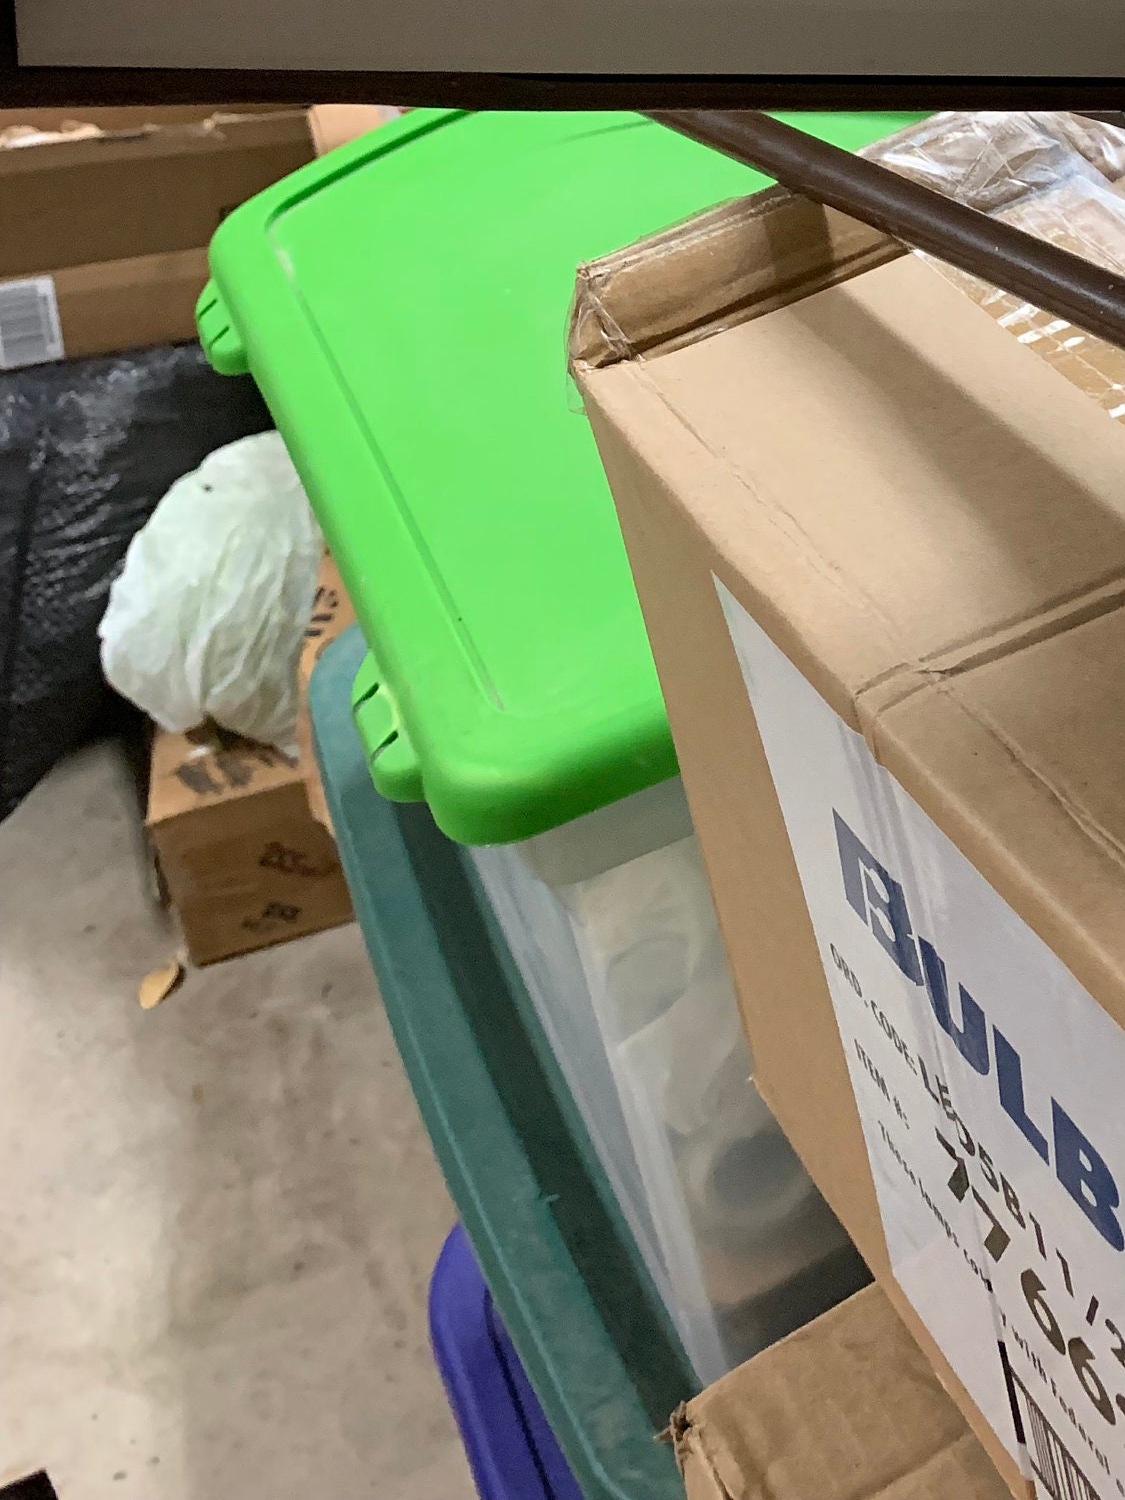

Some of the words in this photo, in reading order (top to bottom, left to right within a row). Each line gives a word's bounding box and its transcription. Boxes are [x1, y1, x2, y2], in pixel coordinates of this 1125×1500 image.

[854, 1037, 891, 1103] ITEM
[877, 1119, 917, 1187] These
[918, 1177, 960, 1249] lamps
[1011, 1325, 1048, 1385] with
[1050, 1376, 1111, 1476] Federal
